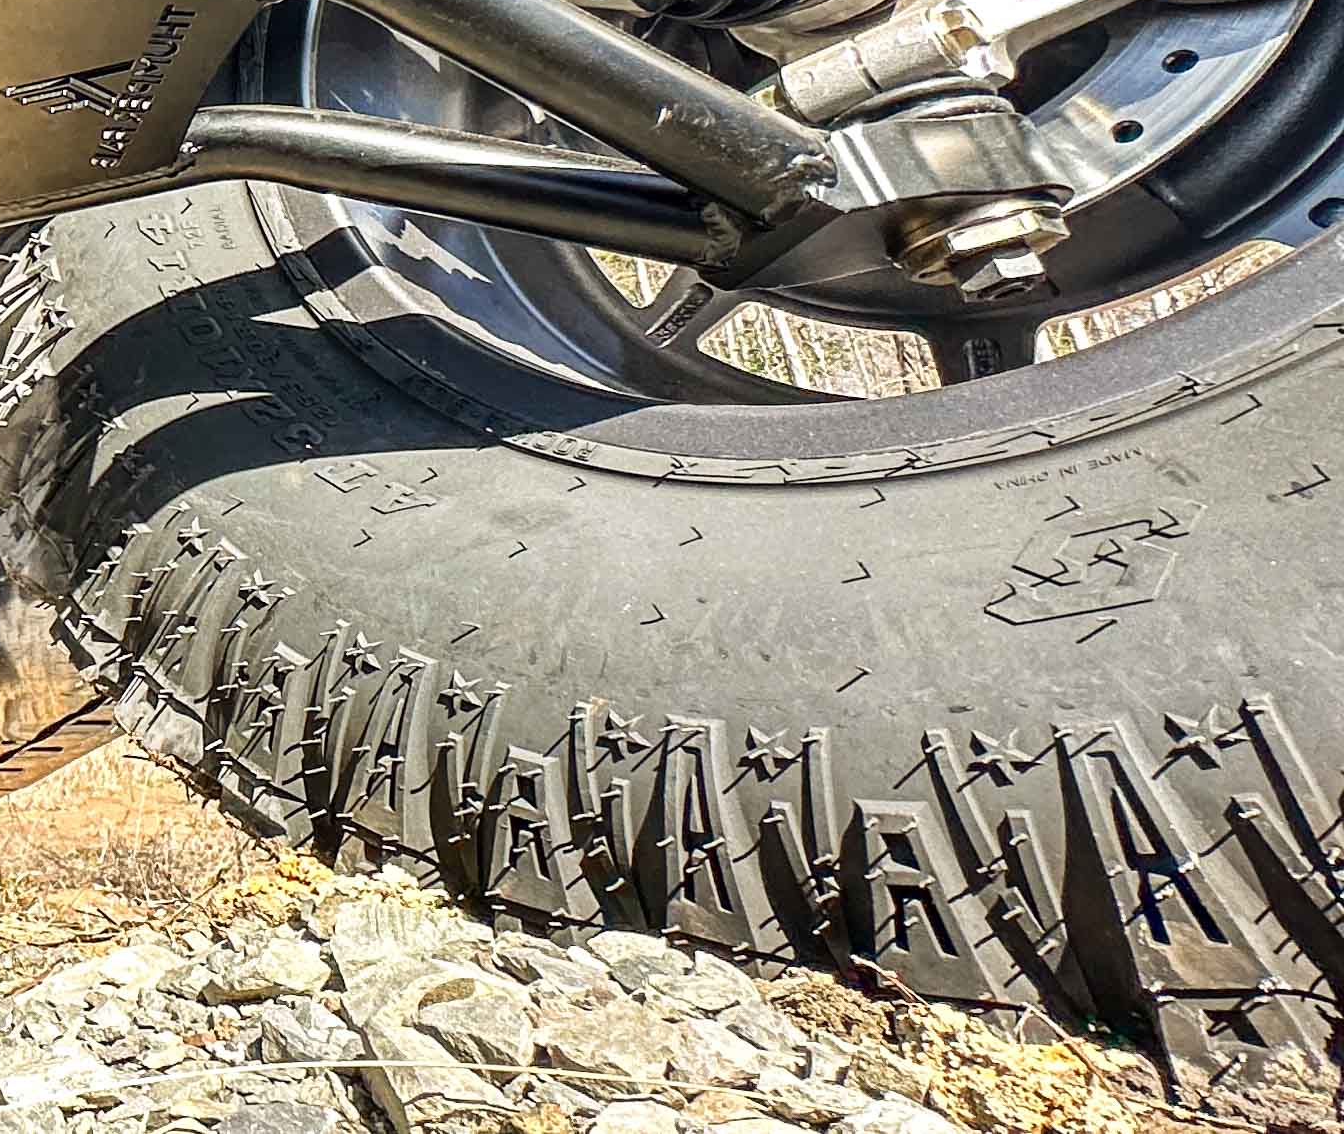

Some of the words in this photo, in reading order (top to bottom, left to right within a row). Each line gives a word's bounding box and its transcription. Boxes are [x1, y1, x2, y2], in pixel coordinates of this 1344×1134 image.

[1087, 447, 1142, 470] MADE
[992, 470, 1052, 492] CHINA
[1057, 464, 1082, 480] IN
